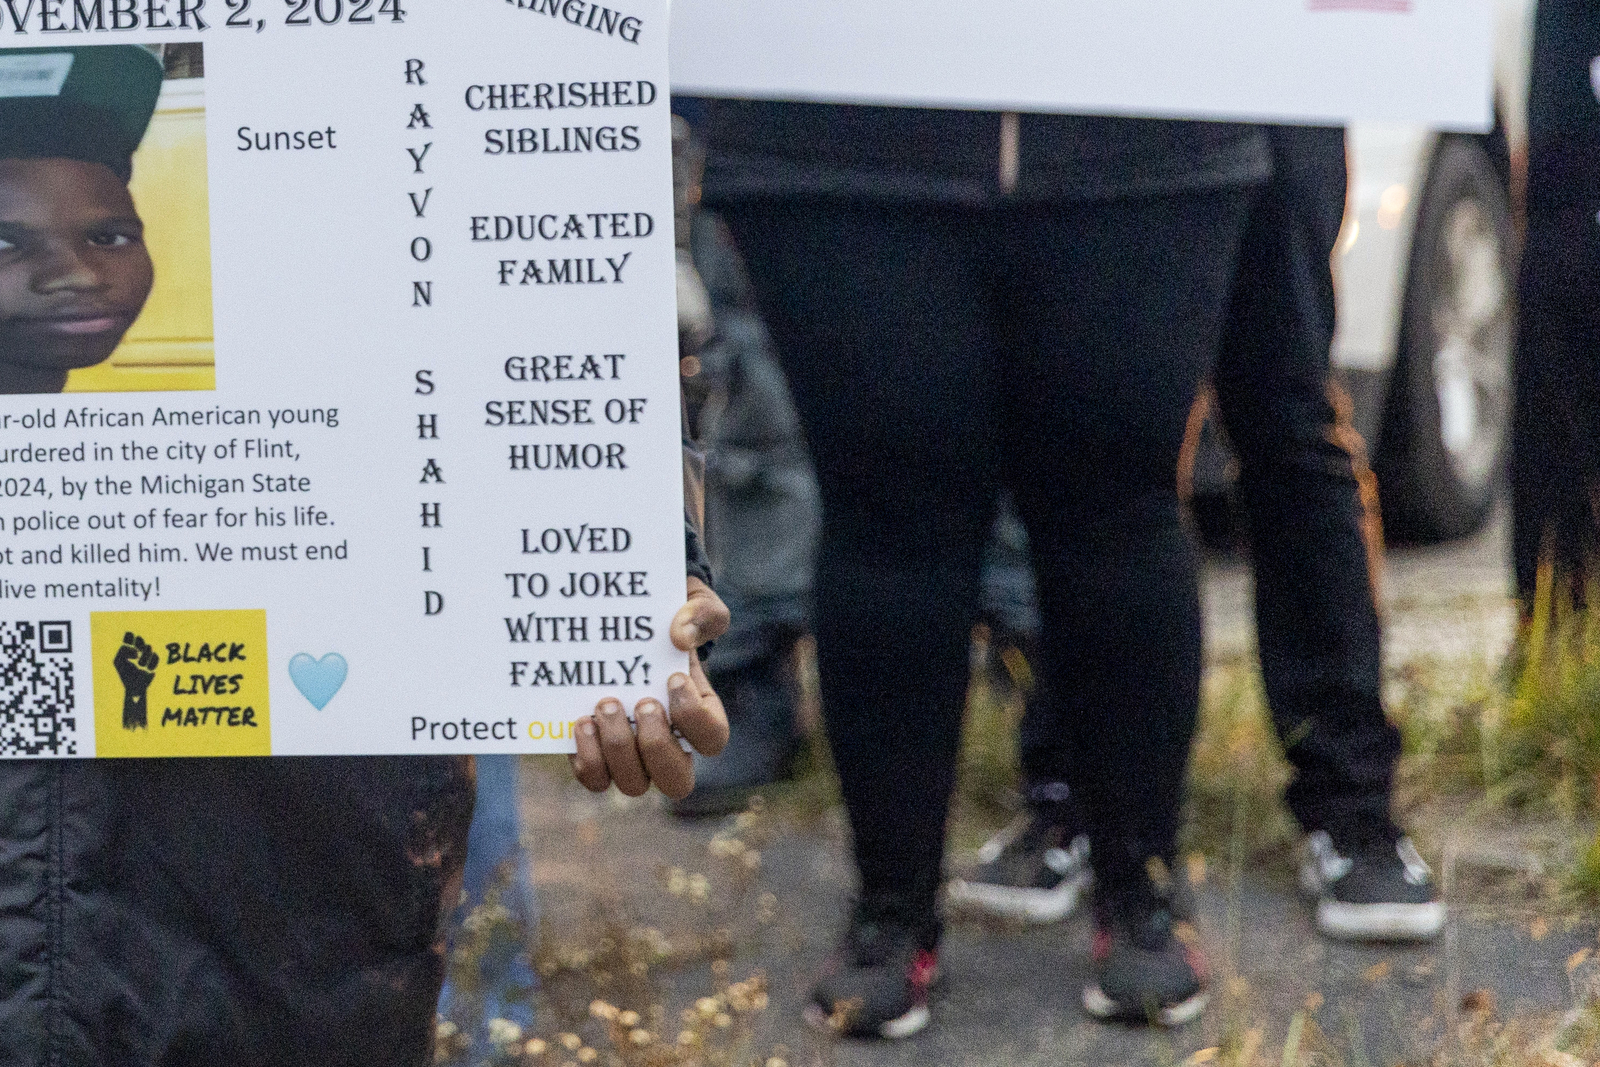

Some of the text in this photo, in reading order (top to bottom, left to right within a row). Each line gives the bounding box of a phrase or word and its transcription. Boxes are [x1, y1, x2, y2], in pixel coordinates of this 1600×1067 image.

[464, 80, 657, 111] CHERISHED
[237, 126, 337, 152] Sunset
[484, 125, 641, 154] SIBLINGS
[470, 212, 654, 241] EDUCATED
[498, 252, 631, 285] FAMILY
[504, 354, 625, 383] GREAT
[64, 407, 144, 427] African
[152, 407, 260, 426] American
[268, 408, 339, 429] young
[485, 398, 647, 426] SENSE OF
[94, 441, 113, 461] in
[121, 441, 158, 461] the
[166, 442, 206, 464] city
[214, 438, 237, 459] of
[245, 438, 300, 460] Flint,
[509, 443, 626, 470] HUMOR
[62, 476, 87, 500] by
[95, 476, 132, 495] the
[141, 474, 244, 498] Michigan
[252, 473, 311, 493] State
[13, 511, 80, 535] police
[87, 512, 125, 530] out
[133, 508, 156, 529] of
[163, 508, 208, 528] fear
[215, 507, 247, 528] for
[255, 507, 286, 527] his
[294, 505, 336, 526] life.
[21, 544, 62, 565] and
[71, 543, 130, 563] killed
[139, 543, 188, 562] him.
[195, 543, 233, 562] We
[241, 543, 297, 561] must
[305, 540, 348, 560] end
[521, 524, 631, 554] LOVED
[44, 577, 159, 601] mentality!
[504, 571, 649, 598] TO JOKE
[504, 612, 654, 642] WITH HIS
[165, 642, 246, 665] BLACK
[510, 655, 650, 686] FAMILY!
[173, 674, 244, 695] LIVES
[161, 706, 257, 727] MATTER
[411, 716, 517, 740] Protect
